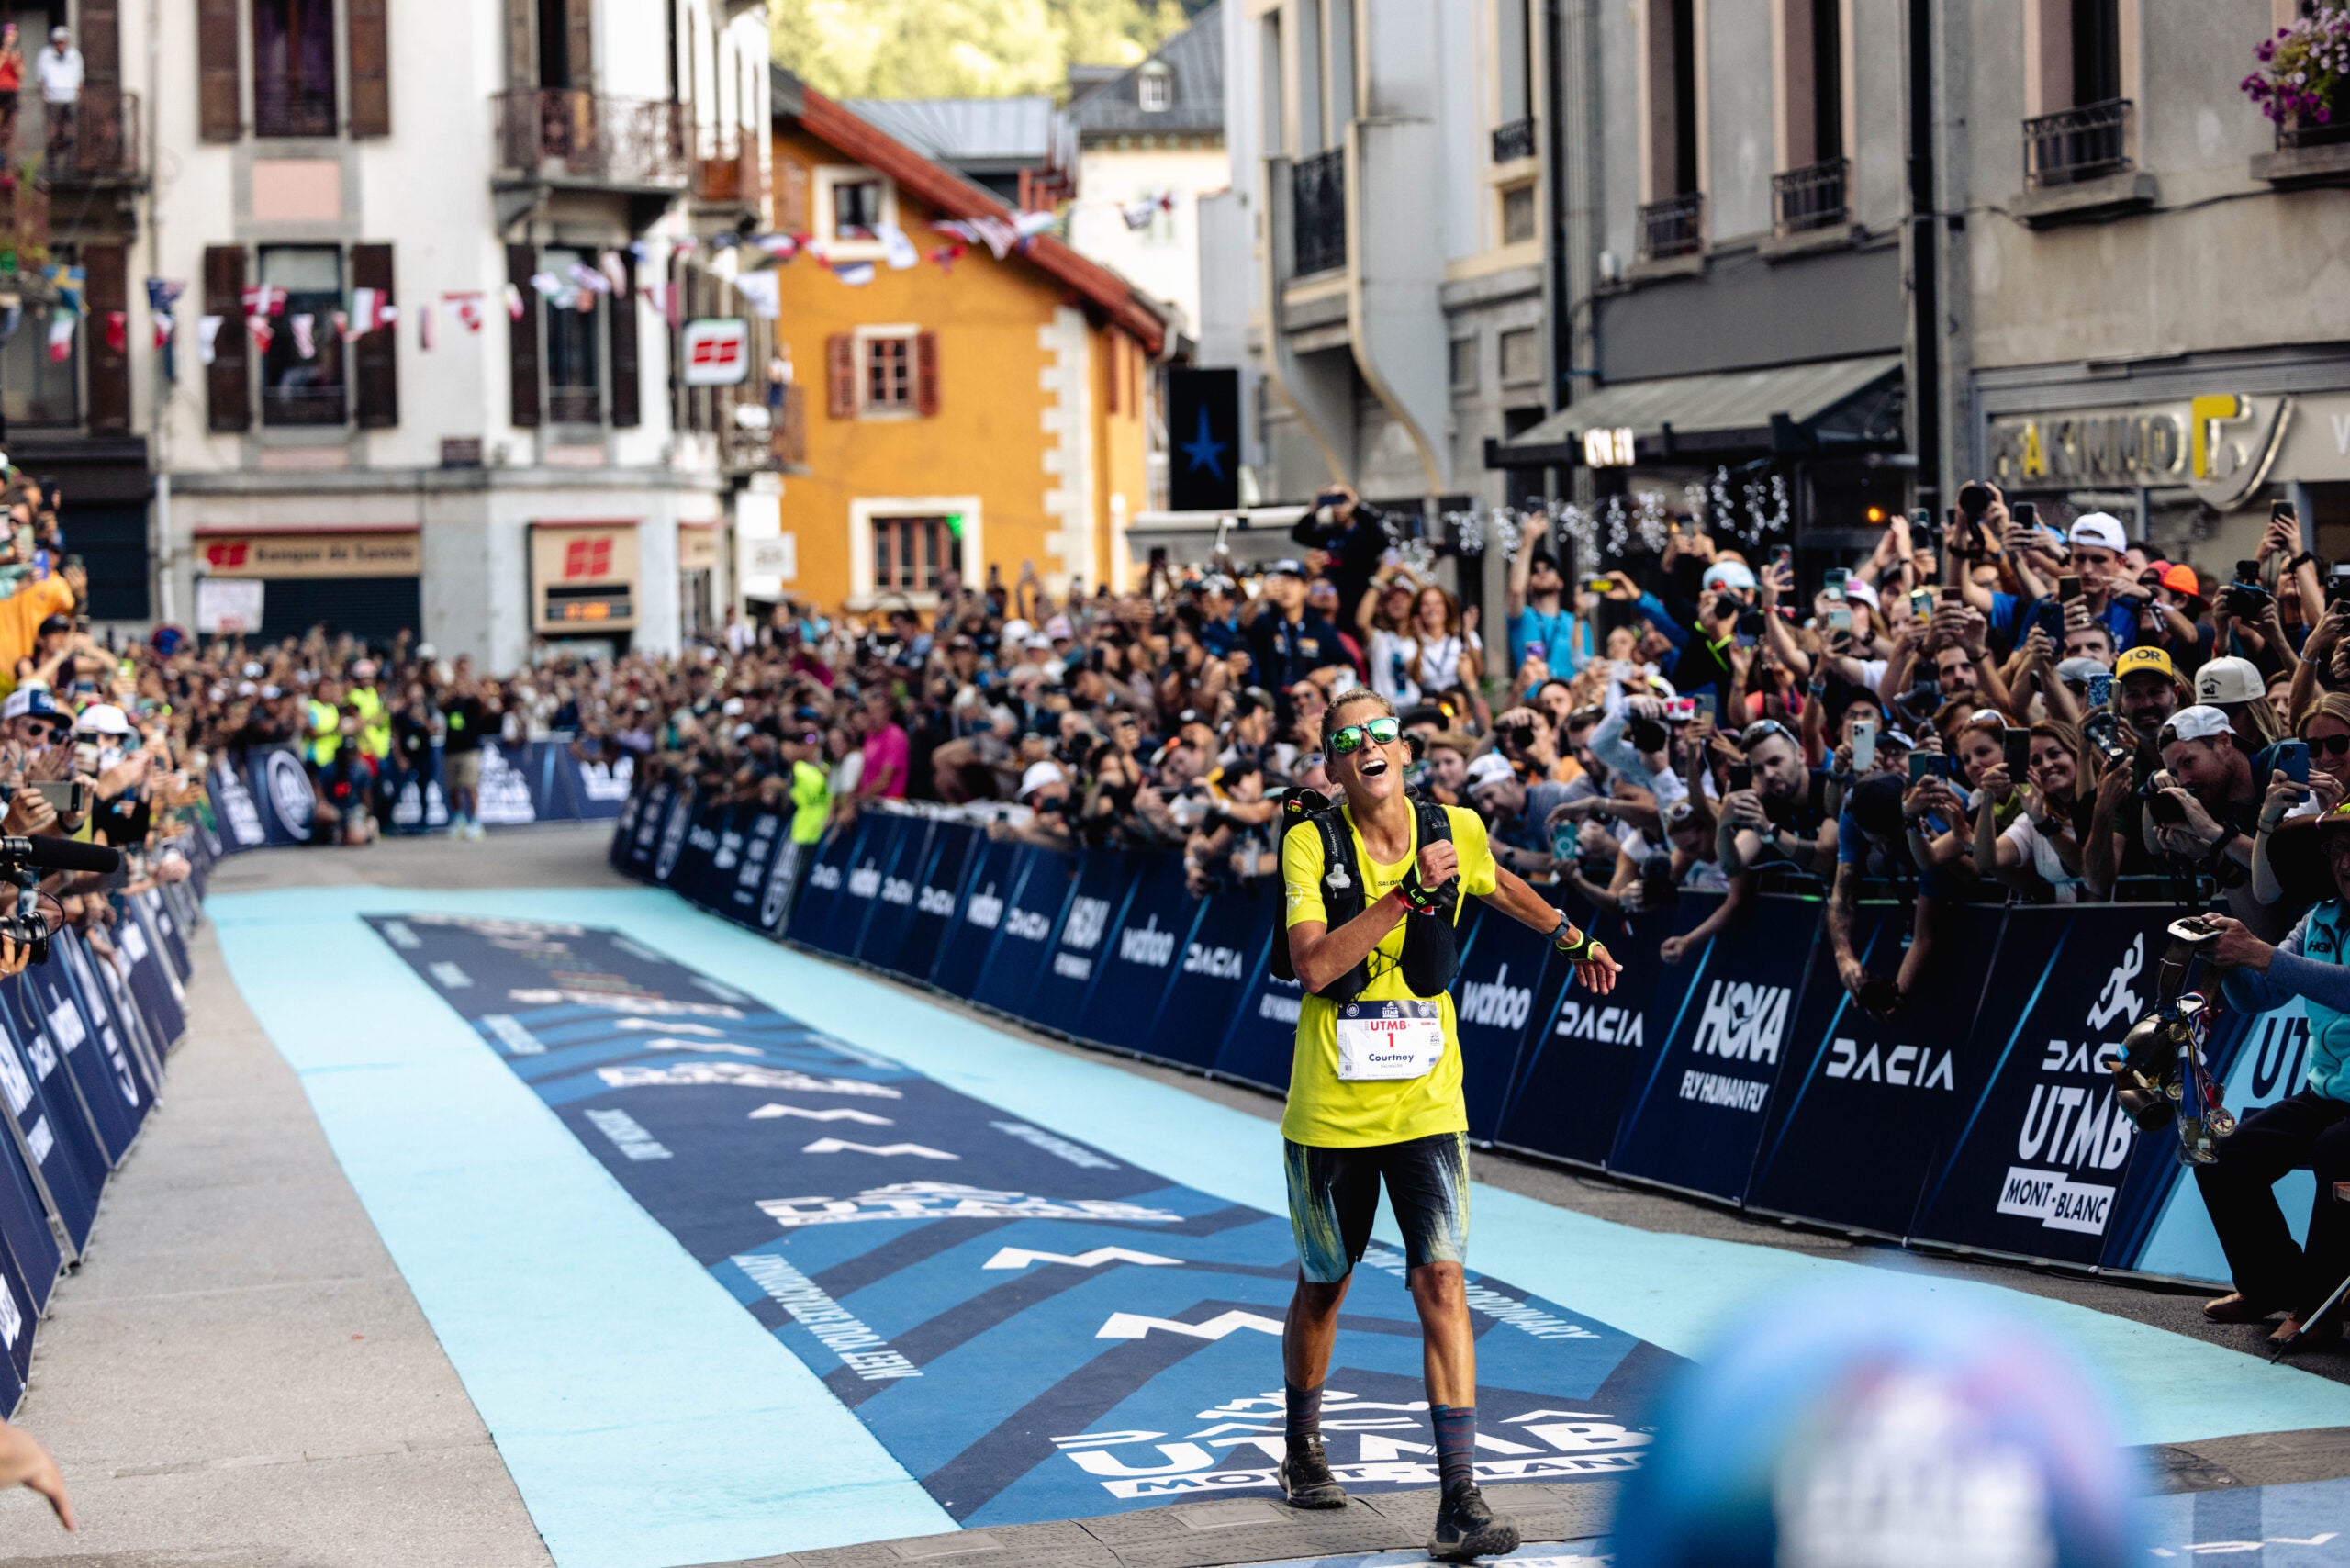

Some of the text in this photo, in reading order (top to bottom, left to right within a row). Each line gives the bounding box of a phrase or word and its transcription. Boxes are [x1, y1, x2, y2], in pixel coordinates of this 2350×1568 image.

[1183, 942, 1243, 980] DACIA
[1460, 962, 1532, 1030] wahoo
[1370, 1020, 1407, 1031] UTMB
[1387, 1032, 1394, 1048] 1
[1555, 1001, 1643, 1047] DACIA
[1692, 979, 1792, 1065] HOKA
[1368, 1053, 1415, 1063] Courtney
[1826, 1037, 1954, 1091] DACIA
[2042, 1039, 2121, 1074] DAC
[2252, 1017, 2311, 1100] UT
[1679, 1069, 1770, 1114] FLY HUMAN FLY
[2019, 1083, 2132, 1170] UTMB
[808, 1319, 889, 1352] YOUR
[839, 1350, 924, 1381] MEET
